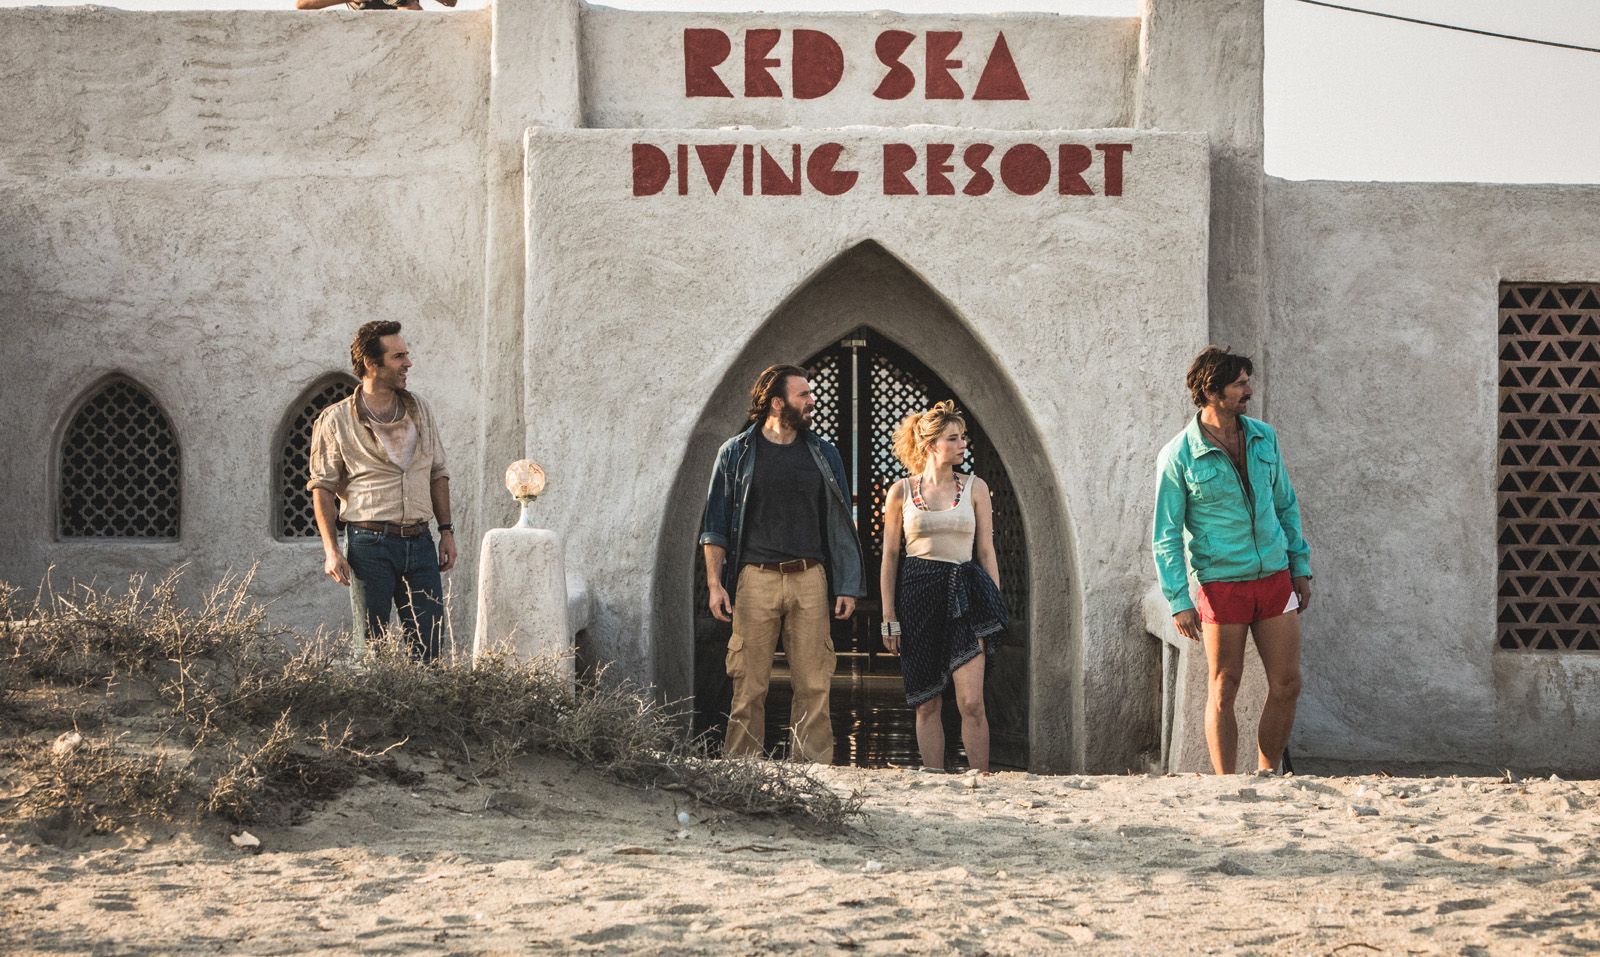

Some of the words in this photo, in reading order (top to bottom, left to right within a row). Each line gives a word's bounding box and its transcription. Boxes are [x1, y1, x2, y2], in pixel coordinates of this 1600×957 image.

[684, 28, 844, 100] RED
[872, 29, 1030, 101] SEA
[632, 143, 859, 197] DIVING
[882, 143, 1133, 197] RESORT
